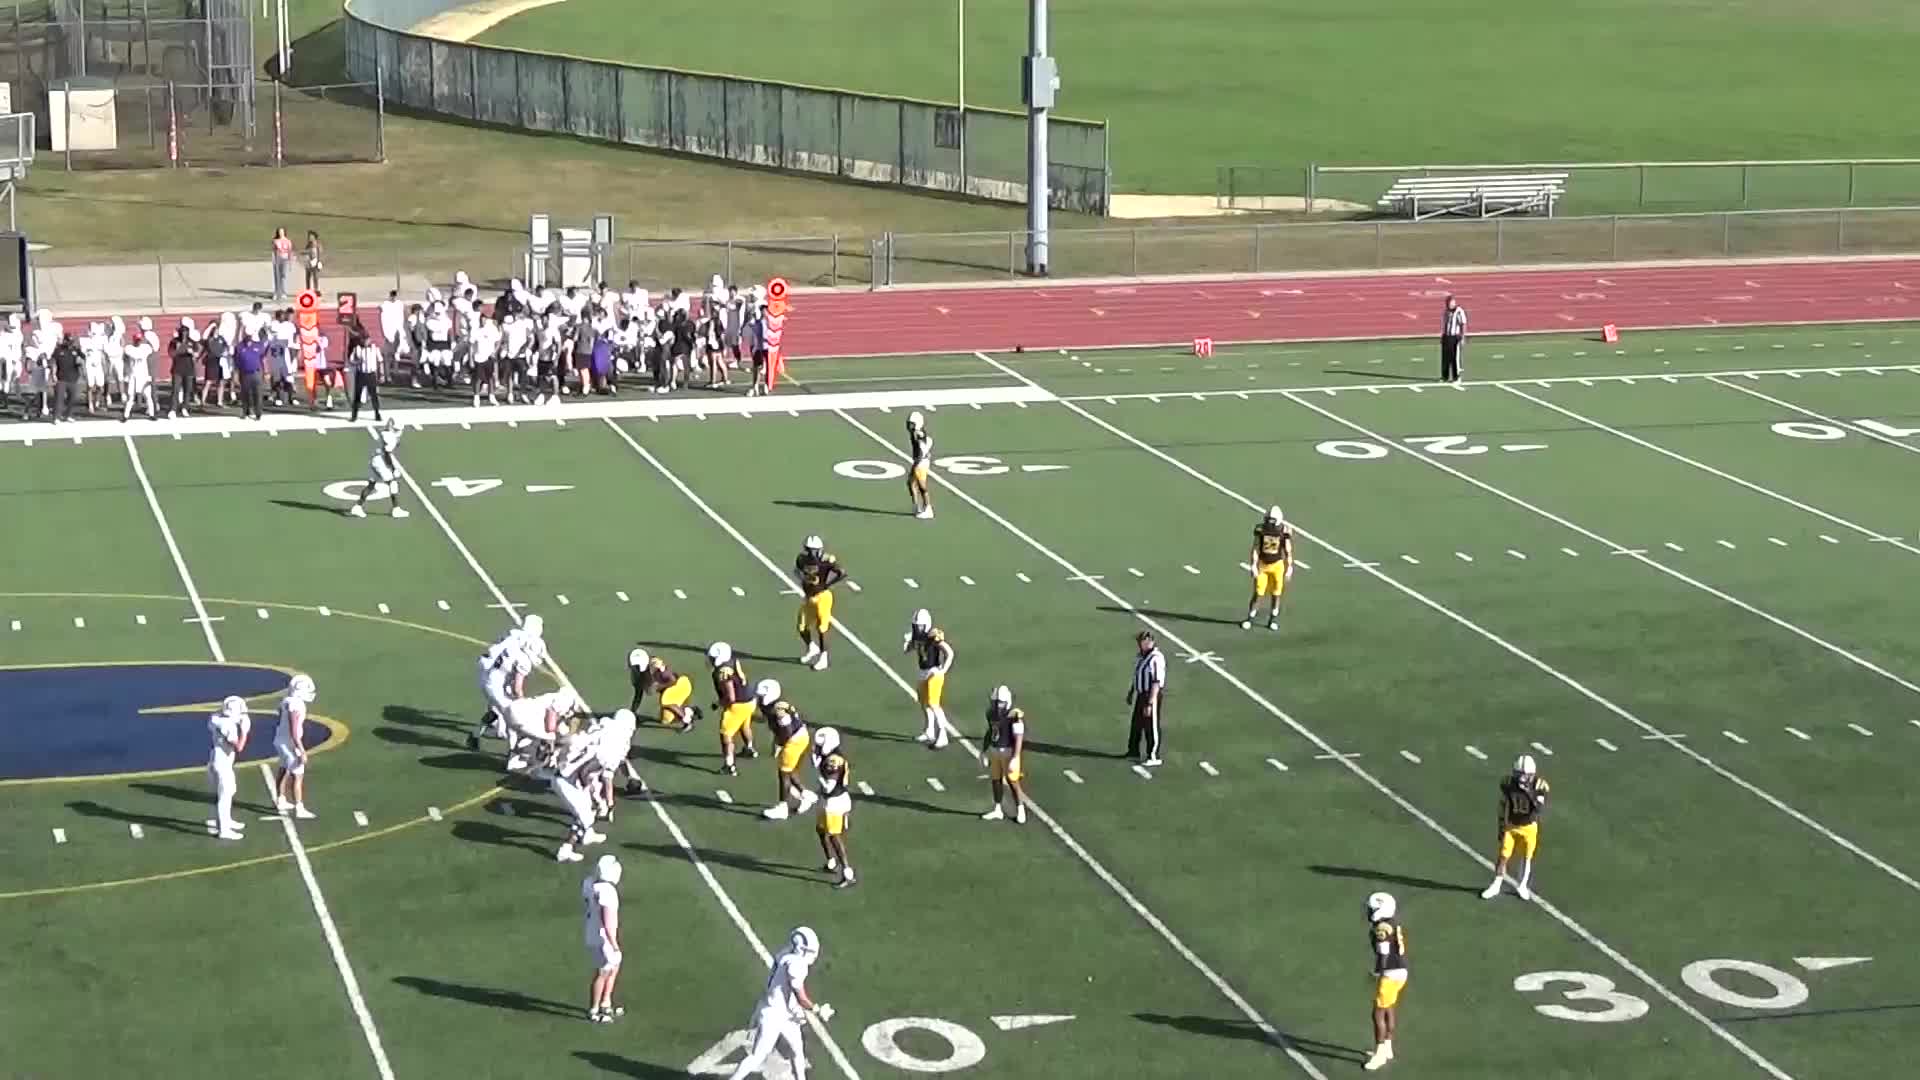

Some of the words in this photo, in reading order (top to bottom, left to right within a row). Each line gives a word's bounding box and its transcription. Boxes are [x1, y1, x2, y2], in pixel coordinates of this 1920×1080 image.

[339, 295, 353, 314] 2
[1315, 435, 1489, 460] 20
[833, 456, 1010, 479] 30
[322, 476, 503, 501] 40
[1513, 958, 1809, 1022] 30
